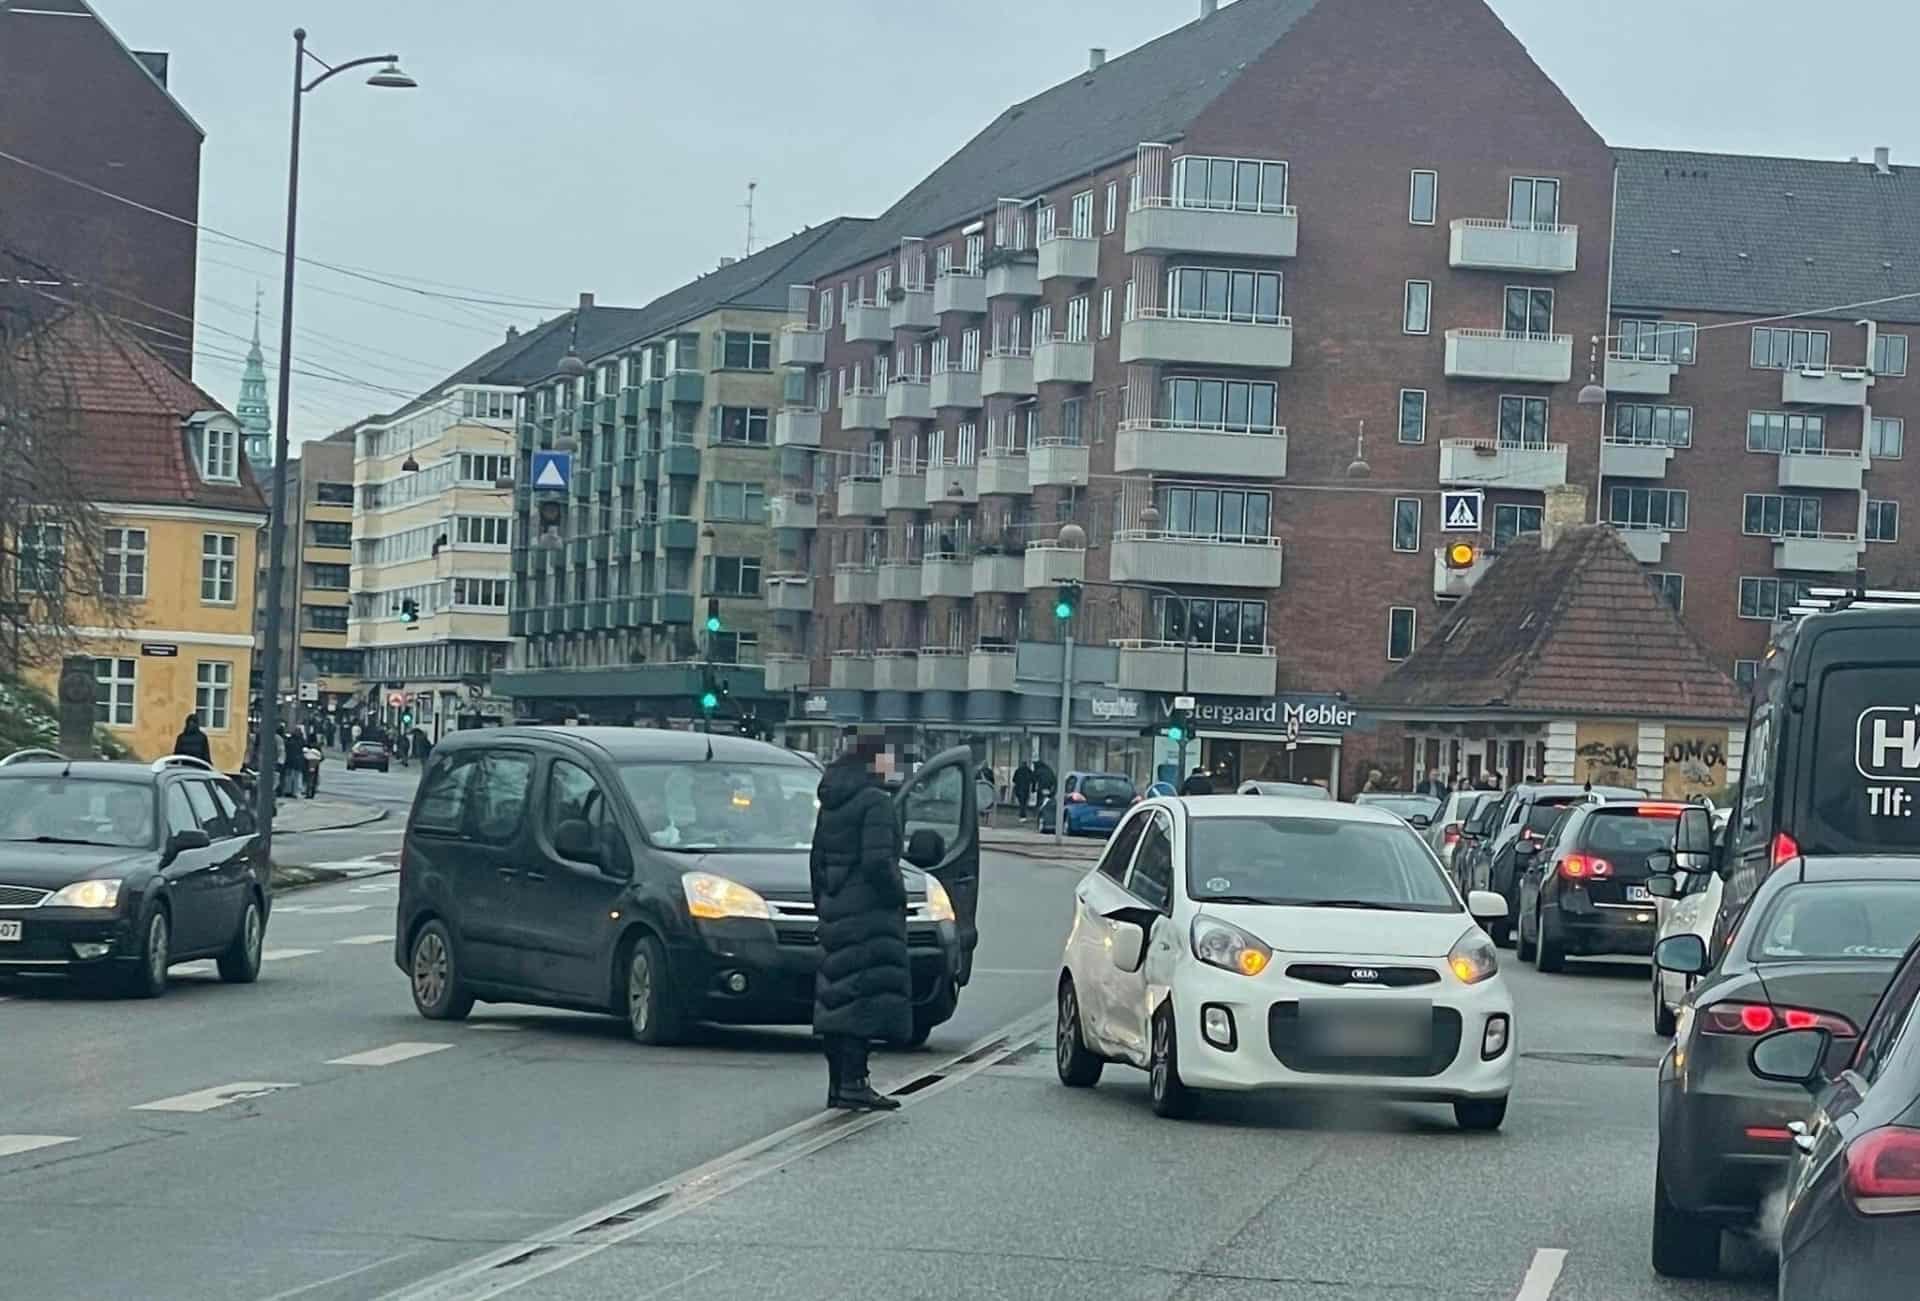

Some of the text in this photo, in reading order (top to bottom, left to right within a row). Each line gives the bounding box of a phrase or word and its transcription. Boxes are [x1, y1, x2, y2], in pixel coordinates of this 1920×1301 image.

[1160, 697, 1276, 725] Vstergaard
[1284, 702, 1357, 726] Møbler
[1867, 787, 1912, 816] Tlf:
